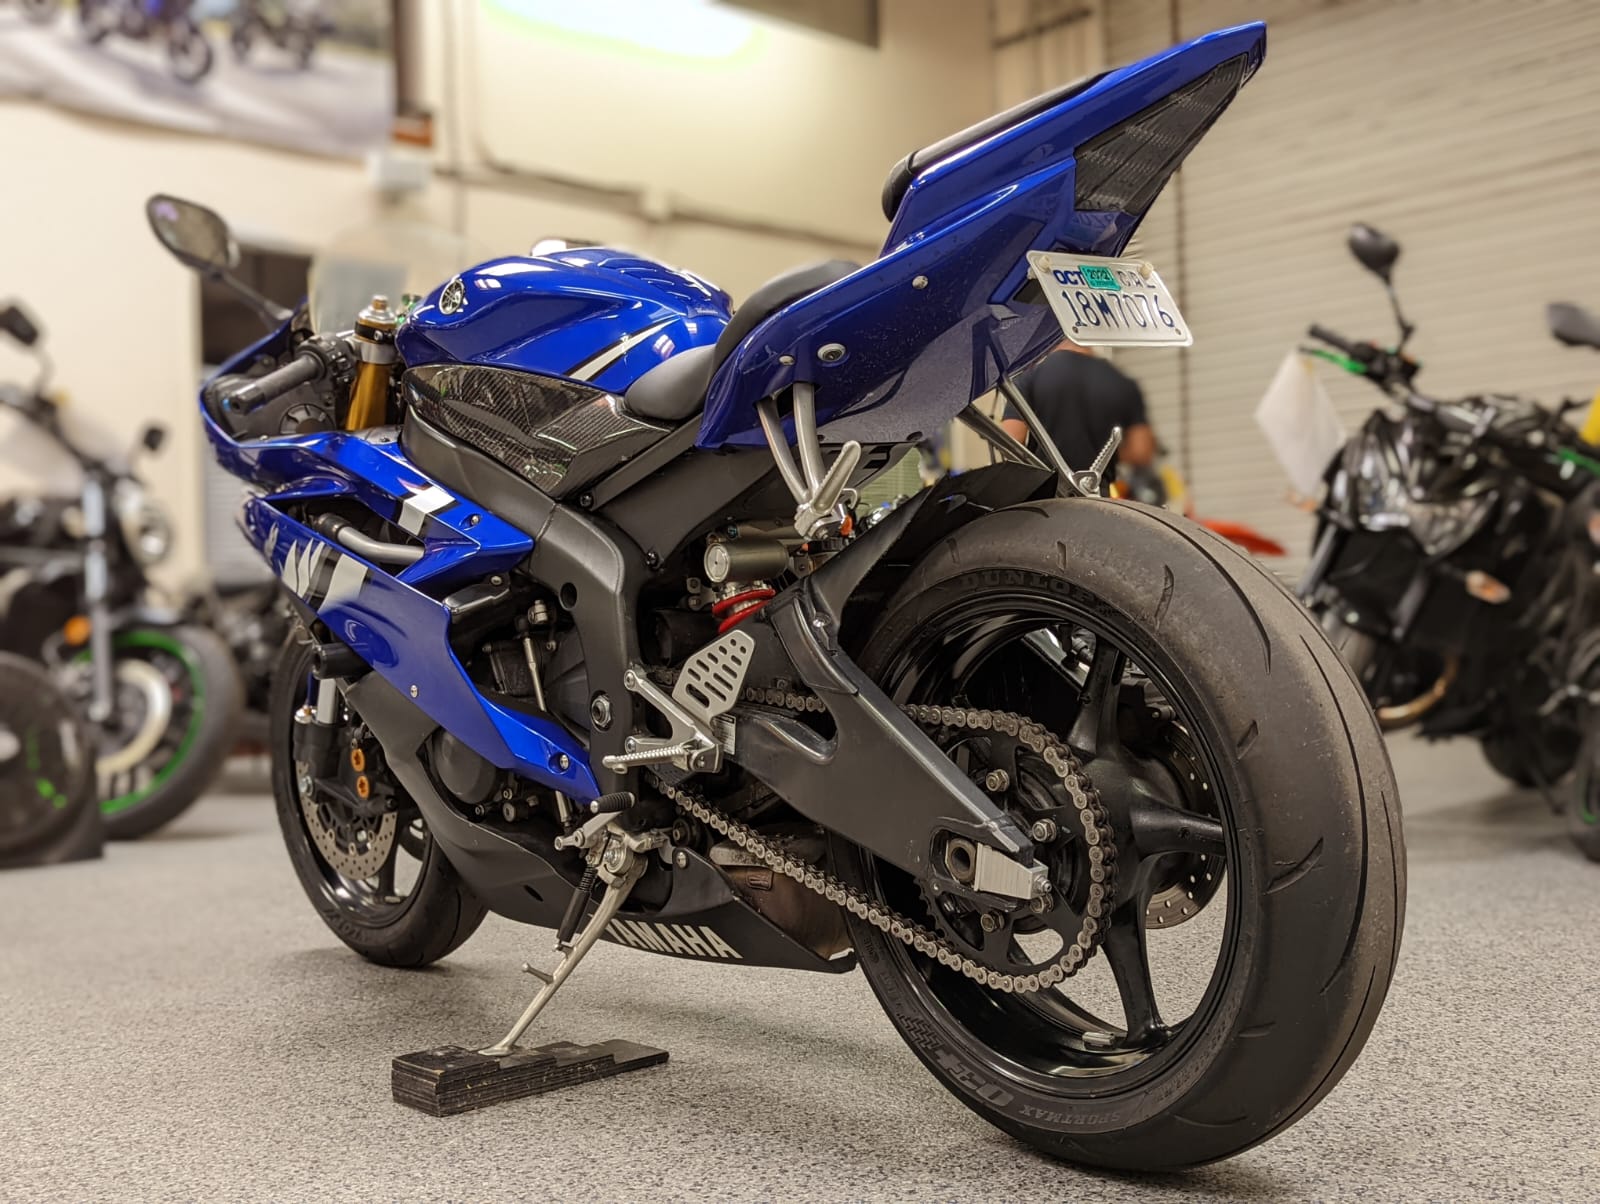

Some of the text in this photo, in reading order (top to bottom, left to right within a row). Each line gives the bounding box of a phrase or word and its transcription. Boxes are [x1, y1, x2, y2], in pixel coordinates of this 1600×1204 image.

[1053, 269, 1087, 286] OCT
[1062, 290, 1175, 328] 18M7076
[1019, 1103, 1122, 1125] SPORTMAX
